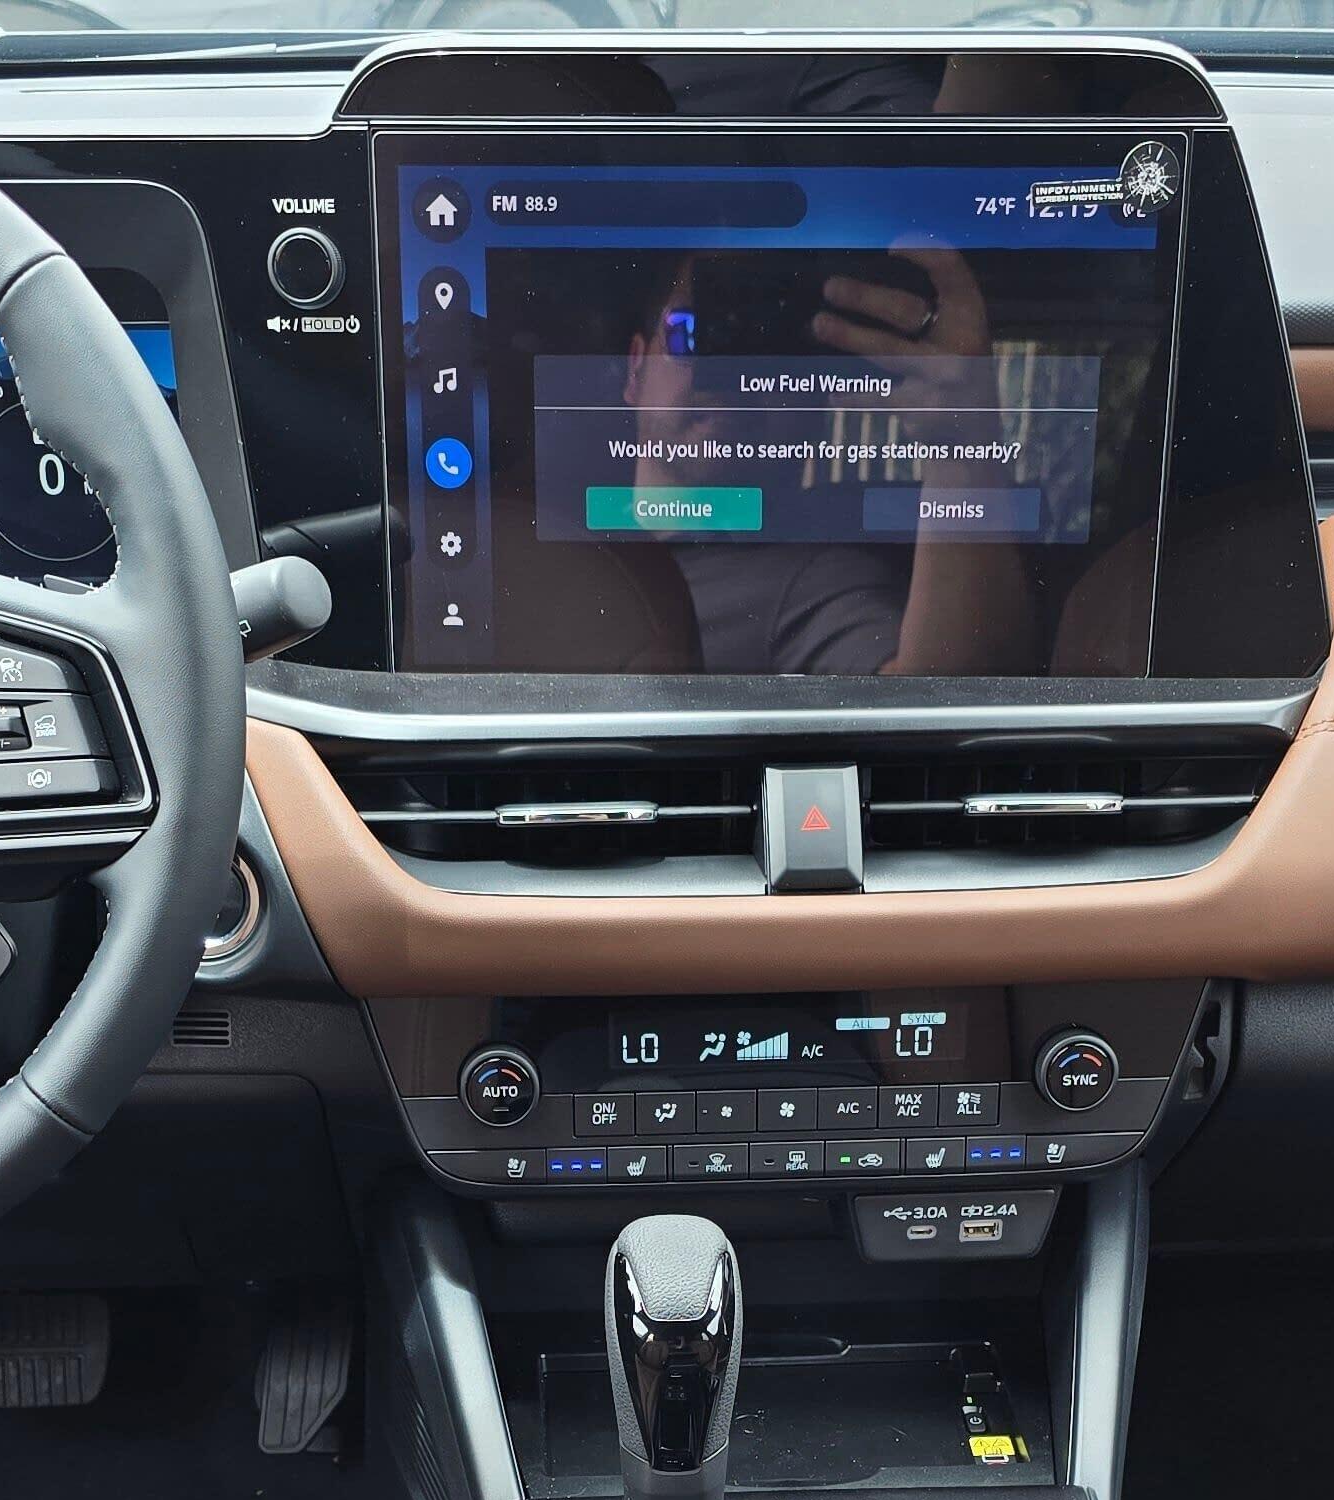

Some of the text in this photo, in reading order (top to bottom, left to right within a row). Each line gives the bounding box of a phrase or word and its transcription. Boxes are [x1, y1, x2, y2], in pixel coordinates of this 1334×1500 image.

[272, 199, 335, 214] VOLUME
[492, 195, 558, 212] FM 88.9
[975, 197, 1016, 215] 74°F
[303, 319, 343, 331] HOLD
[740, 374, 892, 396] Low Fuel Warning
[608, 440, 1021, 464] Would you like to search for gas stations nearby?
[38, 453, 65, 496] 0
[636, 500, 713, 519] Continue
[919, 501, 985, 519] Dismiss
[852, 1018, 873, 1029] ALL
[907, 1014, 940, 1025] SYNC
[622, 1032, 659, 1064] LO
[896, 1026, 933, 1057] LO
[801, 1044, 824, 1058] A/C
[1062, 1073, 1099, 1087] SYNC
[482, 1085, 518, 1098] AUTO
[895, 1093, 922, 1105] MAX
[592, 1102, 616, 1114] ON/
[837, 1102, 860, 1114] A/C
[897, 1105, 920, 1117] A/C
[956, 1103, 981, 1115] ALL
[592, 1114, 617, 1125] OFF
[705, 1164, 733, 1173] FRONT
[785, 1162, 809, 1171] REAR
[913, 1206, 948, 1219] 3.0A
[983, 1204, 1018, 1217] 2.4A
